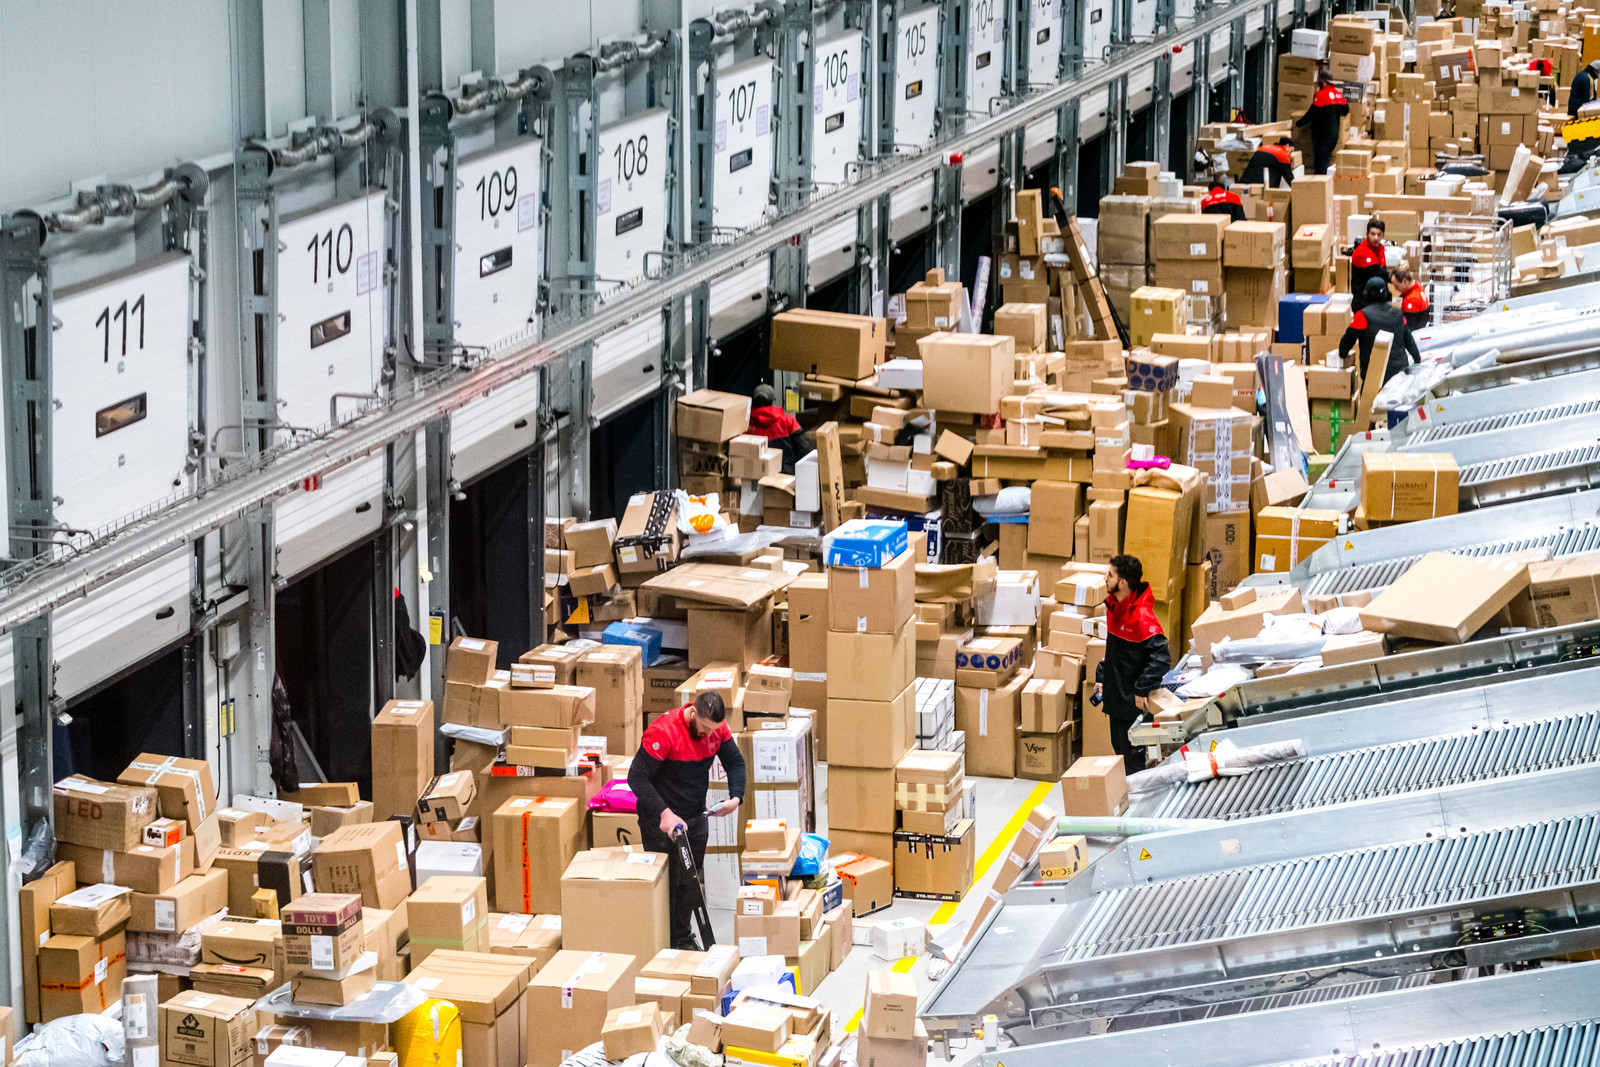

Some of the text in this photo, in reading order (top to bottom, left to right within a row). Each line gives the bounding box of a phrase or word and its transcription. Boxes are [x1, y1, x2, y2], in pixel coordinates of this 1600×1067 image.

[976, 0, 994, 32] 104
[905, 22, 926, 60] 105
[823, 50, 848, 90] 106
[728, 81, 756, 125] 107
[613, 135, 648, 184] 108
[476, 165, 518, 221] 109
[307, 223, 354, 284] 110
[95, 293, 145, 363] 111
[1023, 742, 1047, 754] Viper
[66, 799, 103, 820] LED
[296, 926, 323, 935] DOLLS
[303, 914, 328, 924] TOYS
